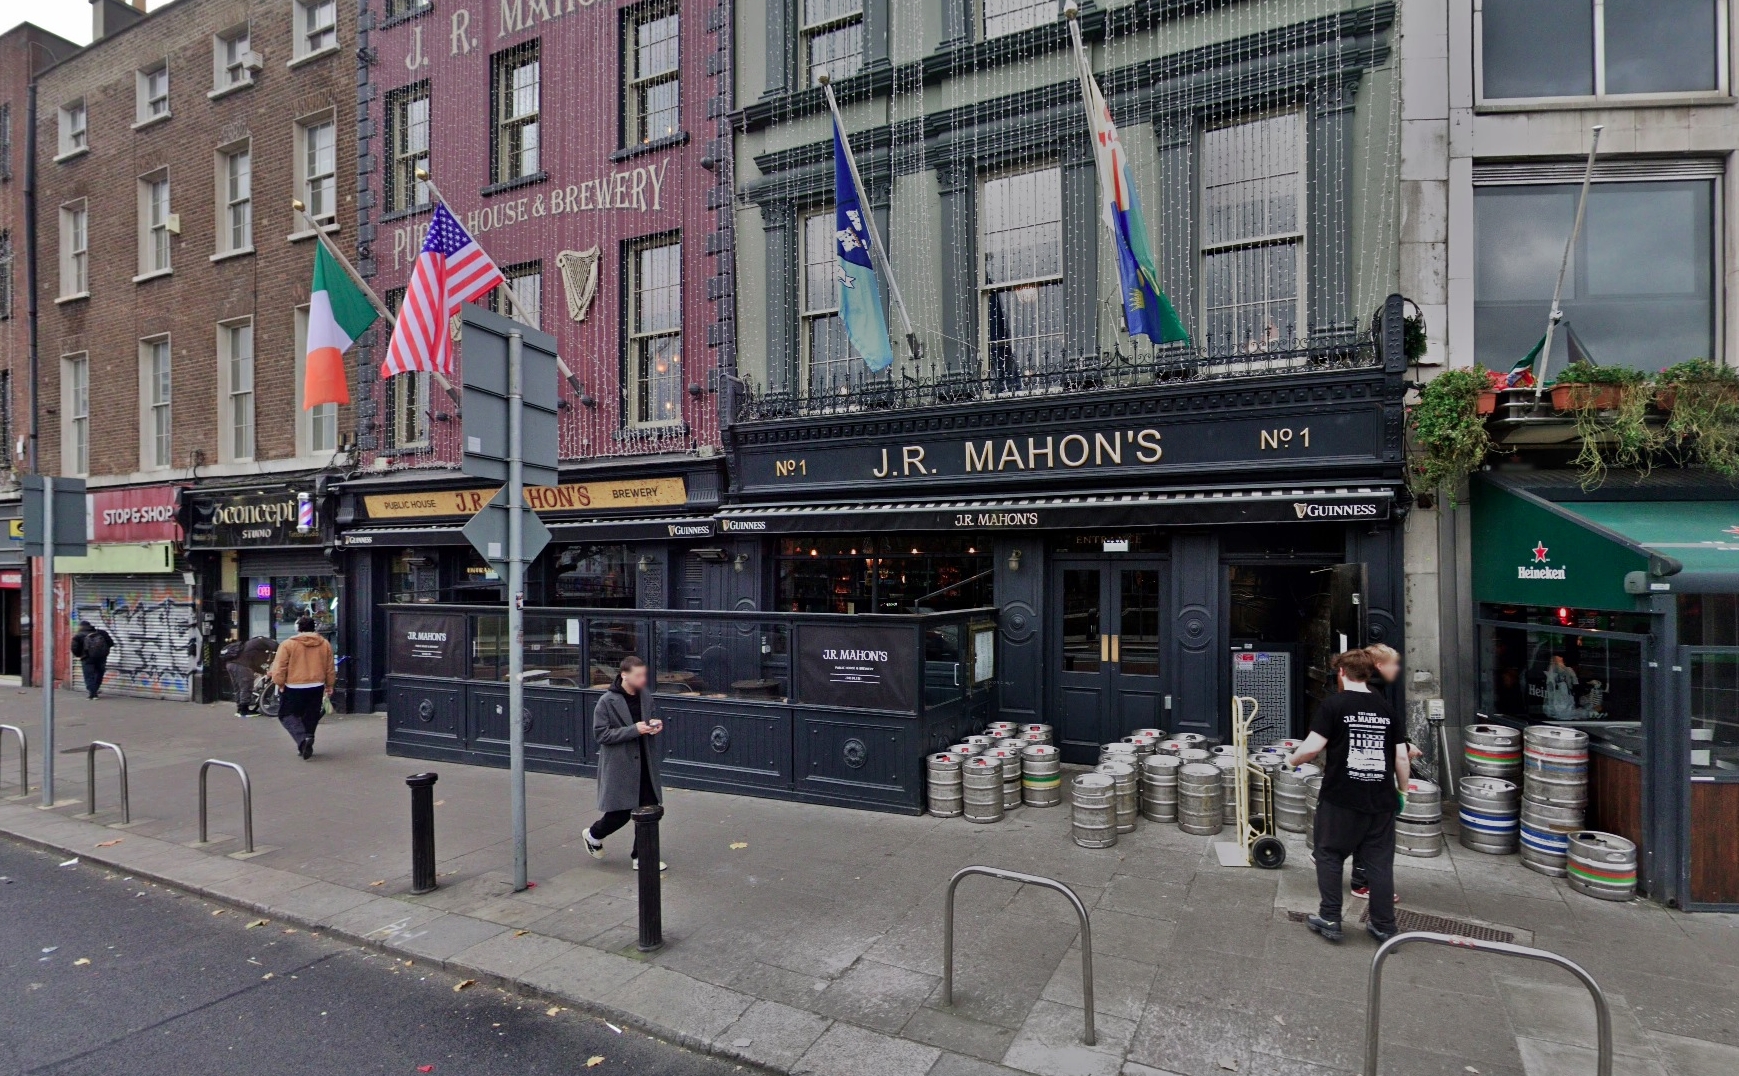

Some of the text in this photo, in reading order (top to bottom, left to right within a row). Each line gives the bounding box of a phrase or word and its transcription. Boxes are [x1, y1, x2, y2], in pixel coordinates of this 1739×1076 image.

[467, 198, 528, 237] HOUSE
[532, 194, 546, 218] &
[551, 156, 670, 214] BREWERY
[965, 428, 1163, 472] MAHON'S
[612, 486, 658, 499] BREWERY
[384, 499, 437, 510] PUBLIC HOUSE
[1306, 504, 1377, 517] GUINNESS
[103, 505, 174, 526] STOP&SHOP
[977, 512, 1038, 526] MAHON'S
[674, 525, 710, 535] GUINNESS
[729, 521, 766, 530] GUINNESS
[242, 528, 272, 540] STUDIO
[349, 536, 373, 544] GUINNESS
[1517, 565, 1566, 580] Heineken
[418, 631, 447, 643] MAHON'S
[839, 649, 888, 662] MAHON'S
[1357, 715, 1391, 725] MAHON'S
